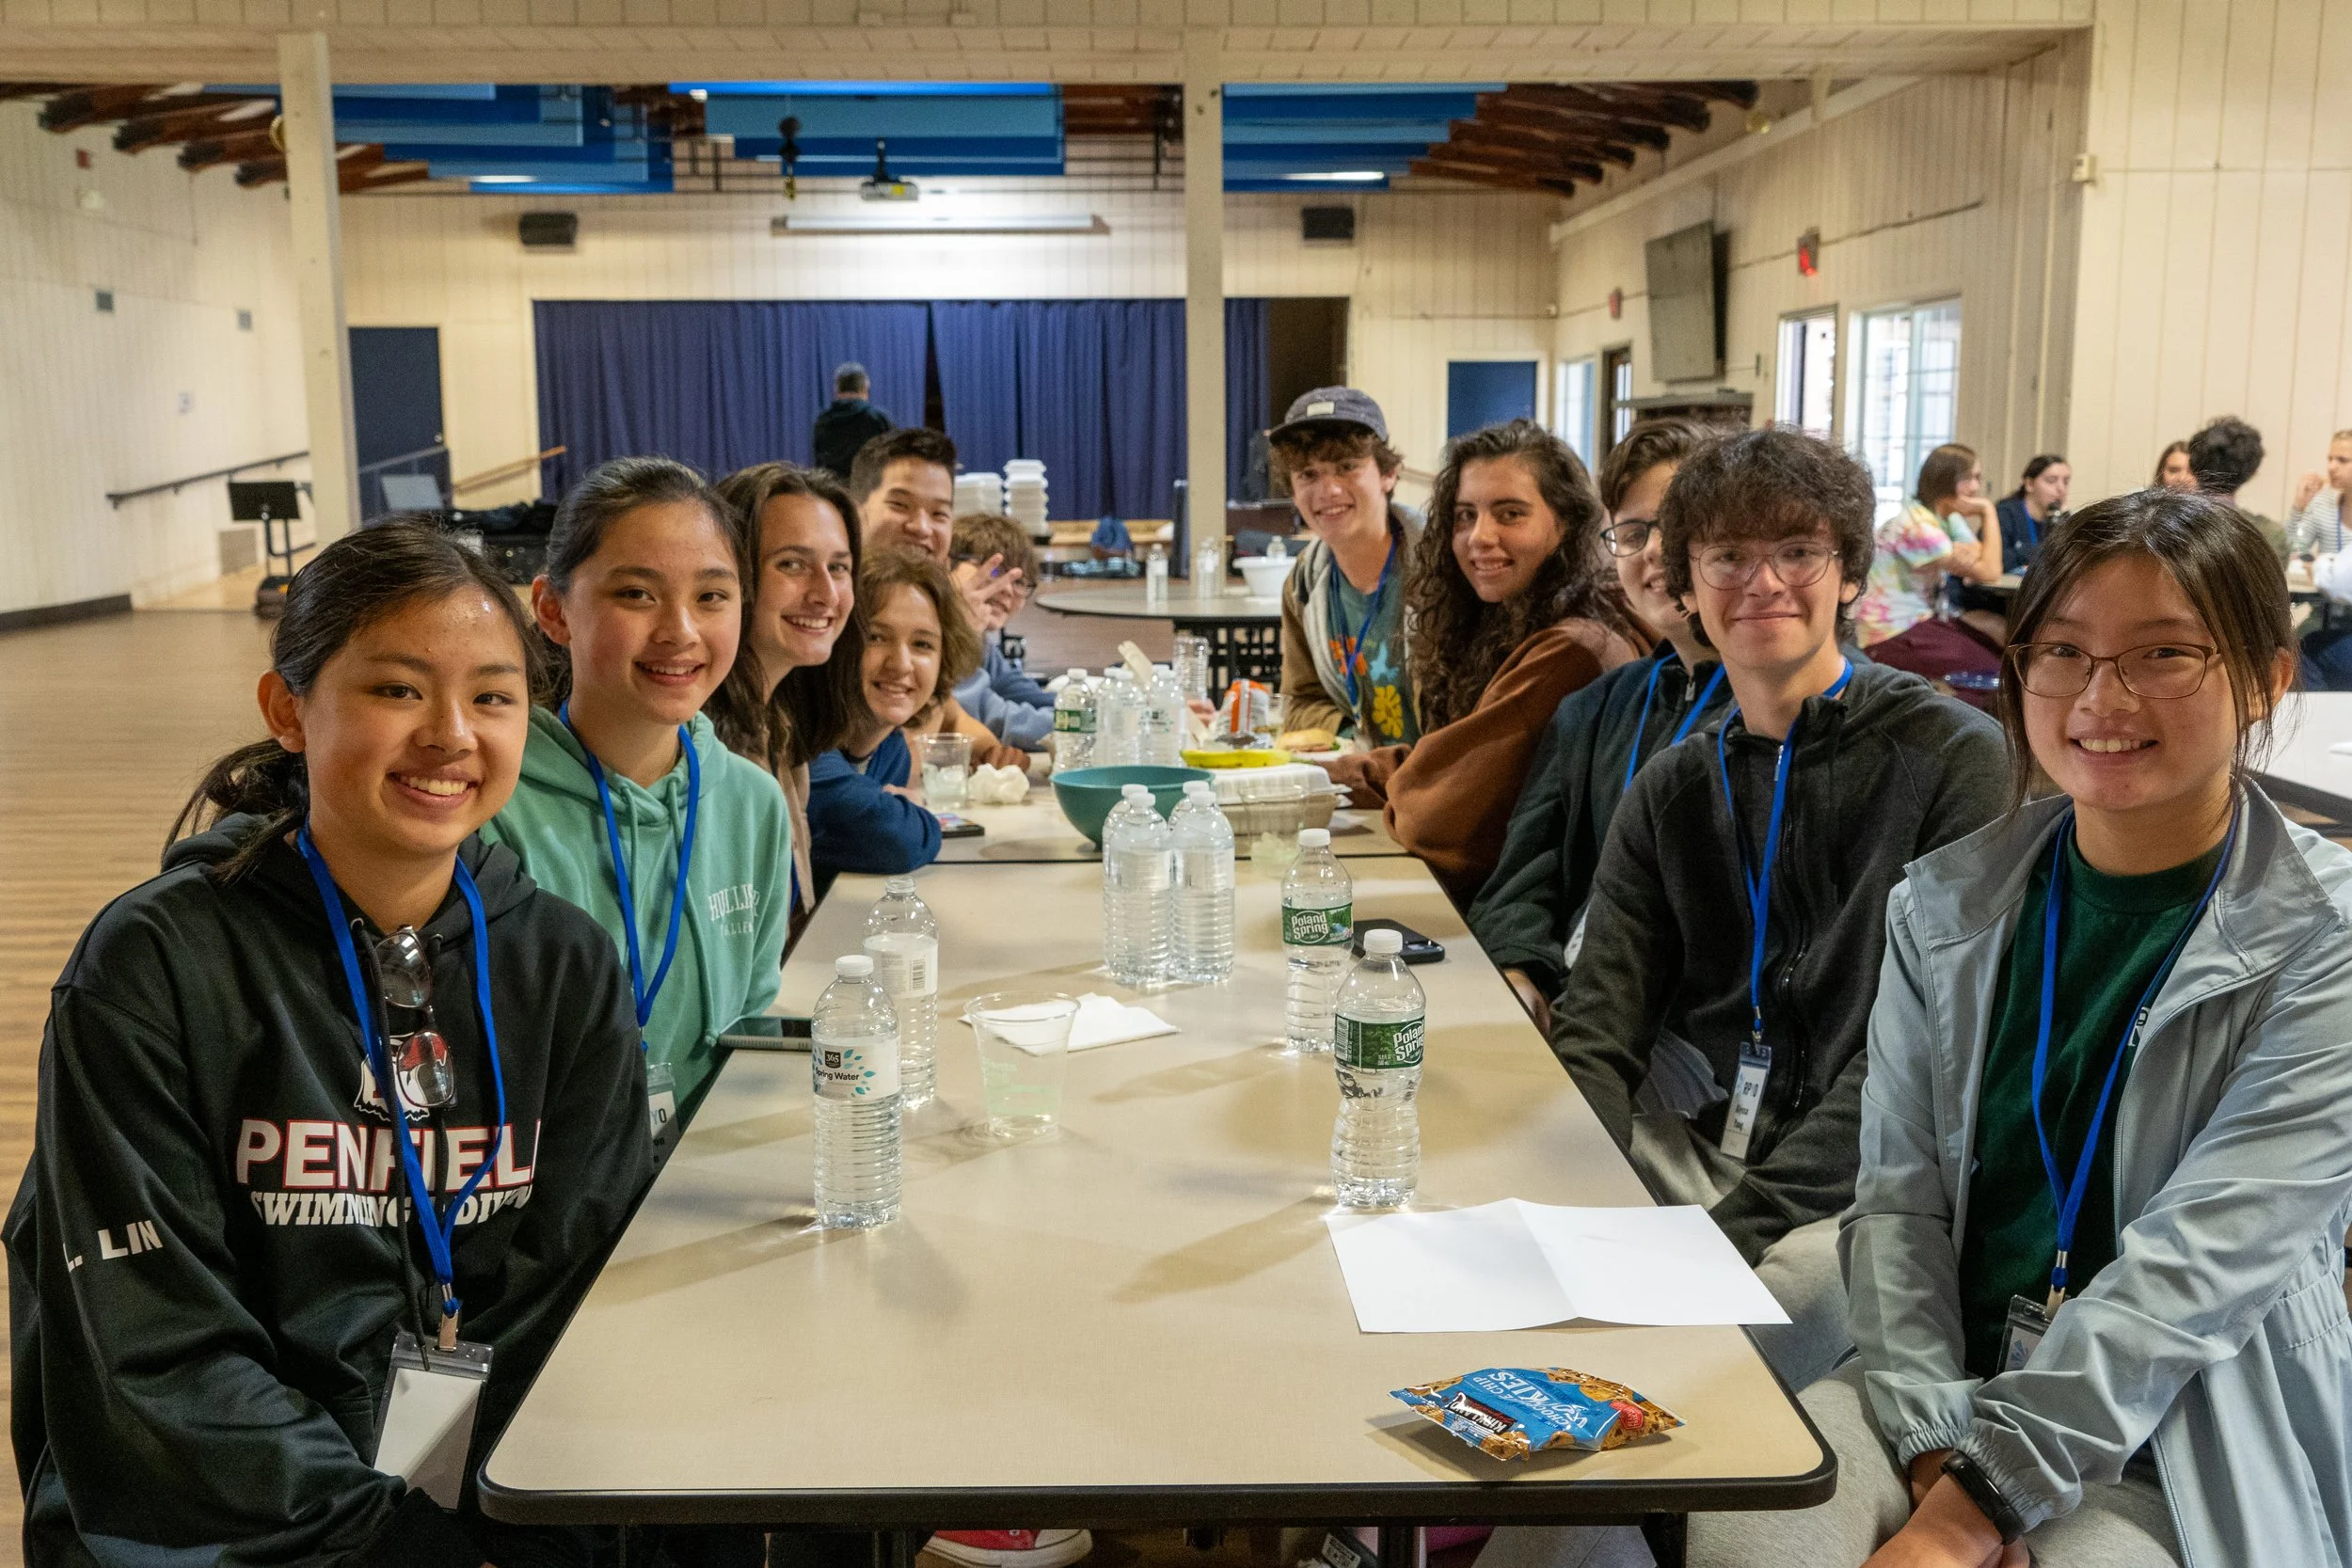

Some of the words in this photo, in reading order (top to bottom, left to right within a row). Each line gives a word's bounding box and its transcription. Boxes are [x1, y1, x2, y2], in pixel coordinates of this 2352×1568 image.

[1291, 911, 1327, 928] Poland
[1293, 923, 1328, 940] Spring
[1392, 1020, 1423, 1048] Polan
[826, 1053, 839, 1063] 365
[834, 1072, 860, 1081] Water
[236, 1117, 541, 1193] PENFIEL
[97, 1220, 164, 1260] LIN
[1472, 1376, 1504, 1394] CHIP
